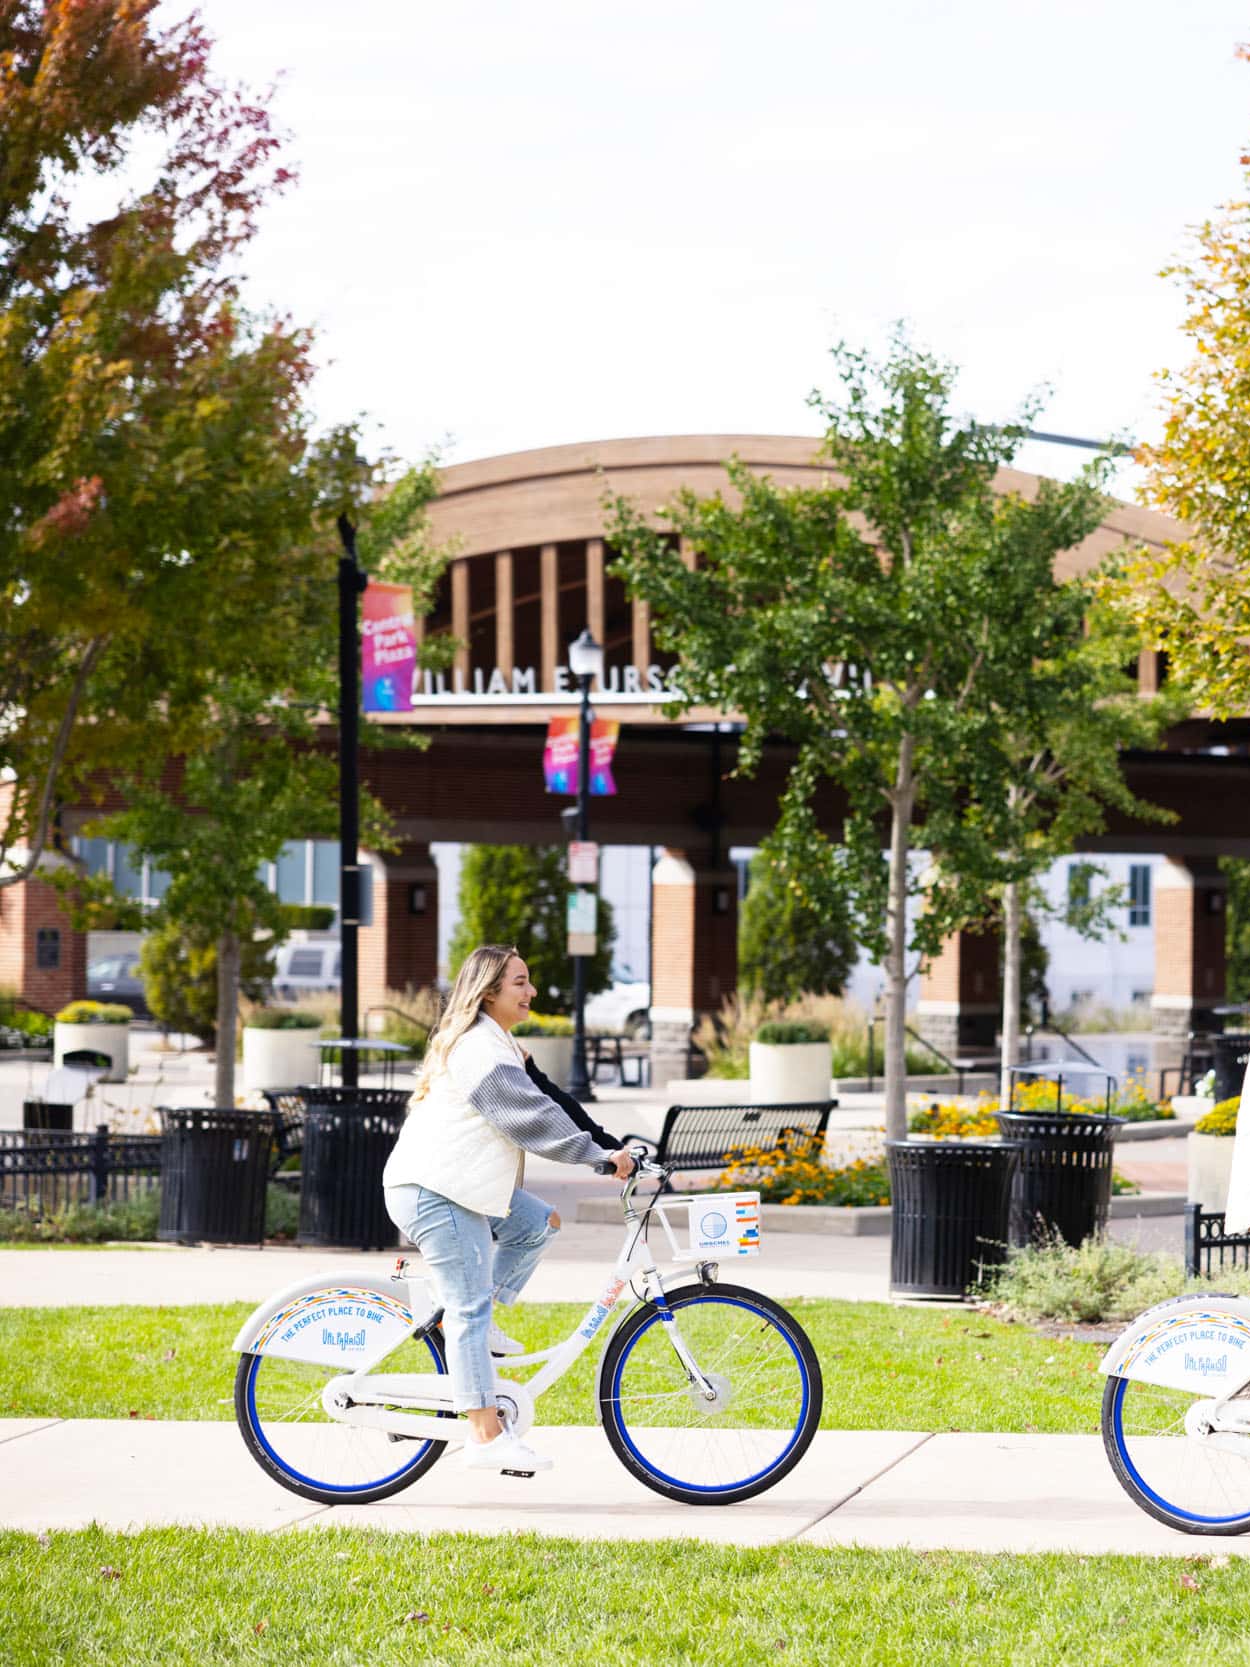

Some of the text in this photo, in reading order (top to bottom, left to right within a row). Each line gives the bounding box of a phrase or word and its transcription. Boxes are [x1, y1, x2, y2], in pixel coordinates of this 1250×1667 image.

[374, 630, 408, 650] Park
[374, 646, 414, 667] Plaza
[281, 1306, 384, 1343] THE PERFECT PLACE TO BIKE
[1144, 1329, 1247, 1367] THE PERFECT PLACE TO BIKE
